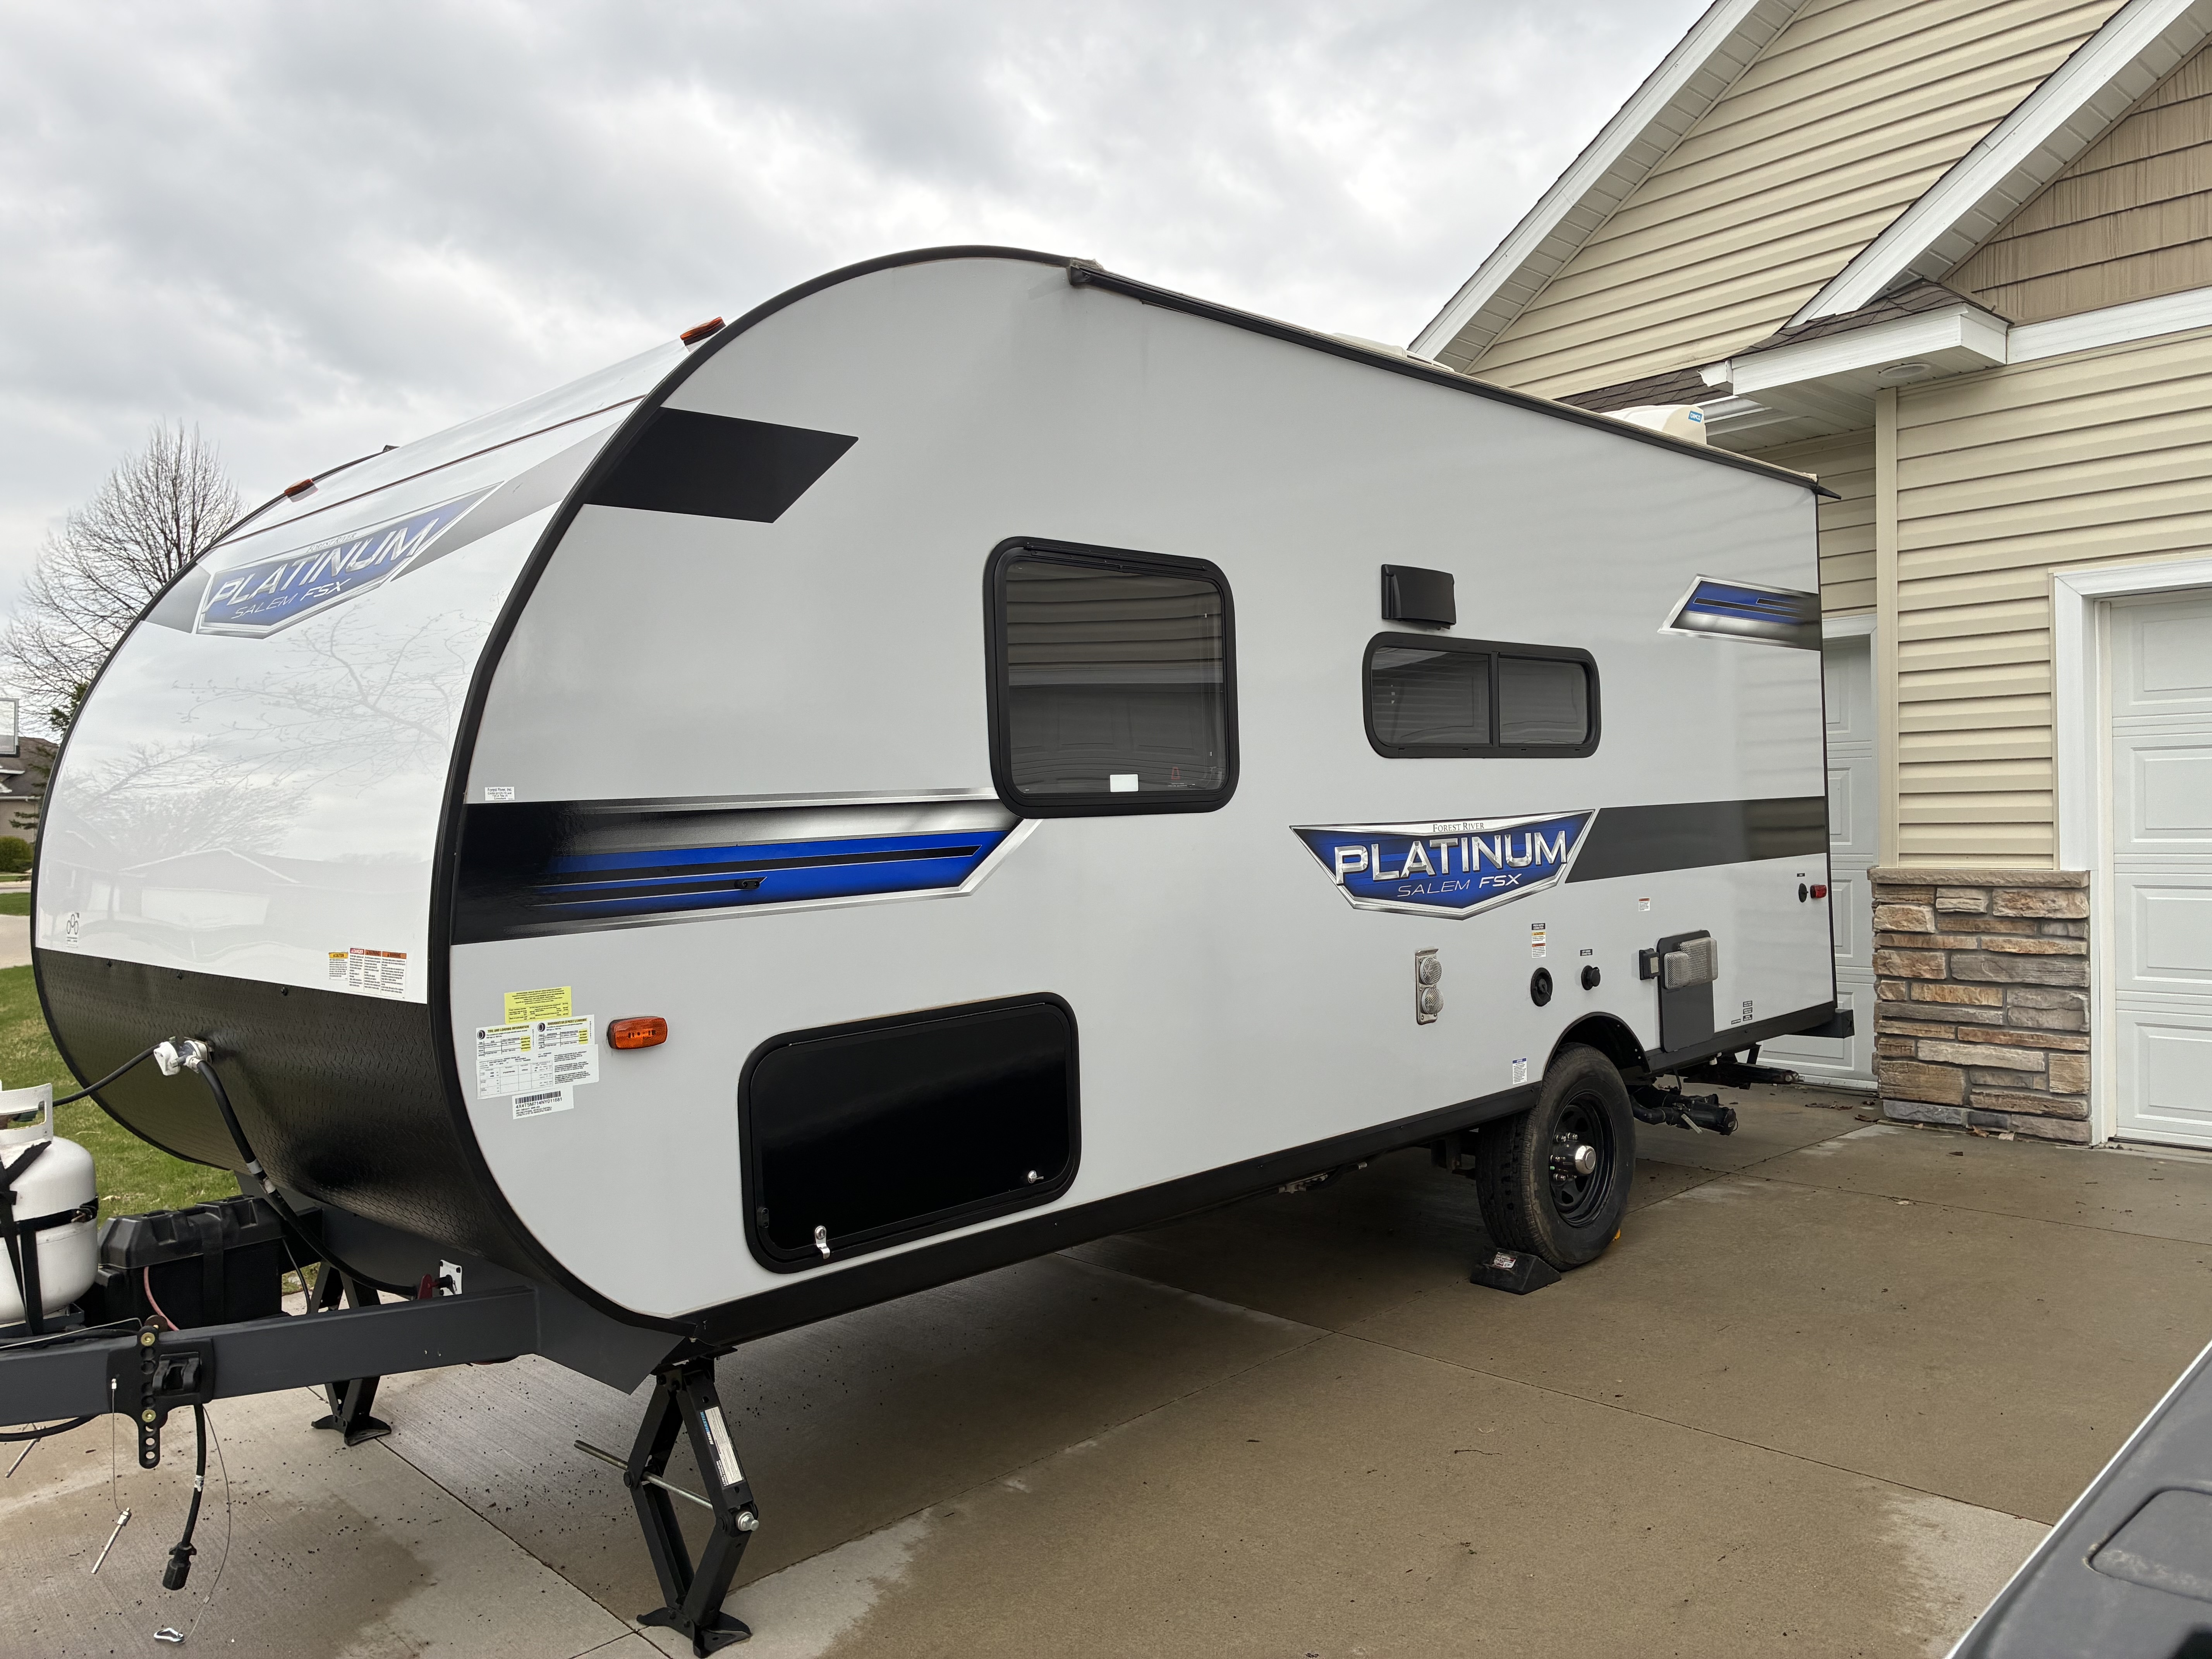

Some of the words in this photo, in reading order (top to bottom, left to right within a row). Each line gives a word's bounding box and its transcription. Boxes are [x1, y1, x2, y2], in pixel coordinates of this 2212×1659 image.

[201, 517, 440, 614] PLATINUM
[231, 593, 298, 619] SALEM
[300, 578, 352, 601] FSX
[1433, 824, 1461, 832] FOREST
[1463, 822, 1484, 830] RIVER
[1334, 831, 1567, 884] PLATINUM
[1397, 879, 1470, 897] SALEM
[1479, 873, 1522, 889] FSX
